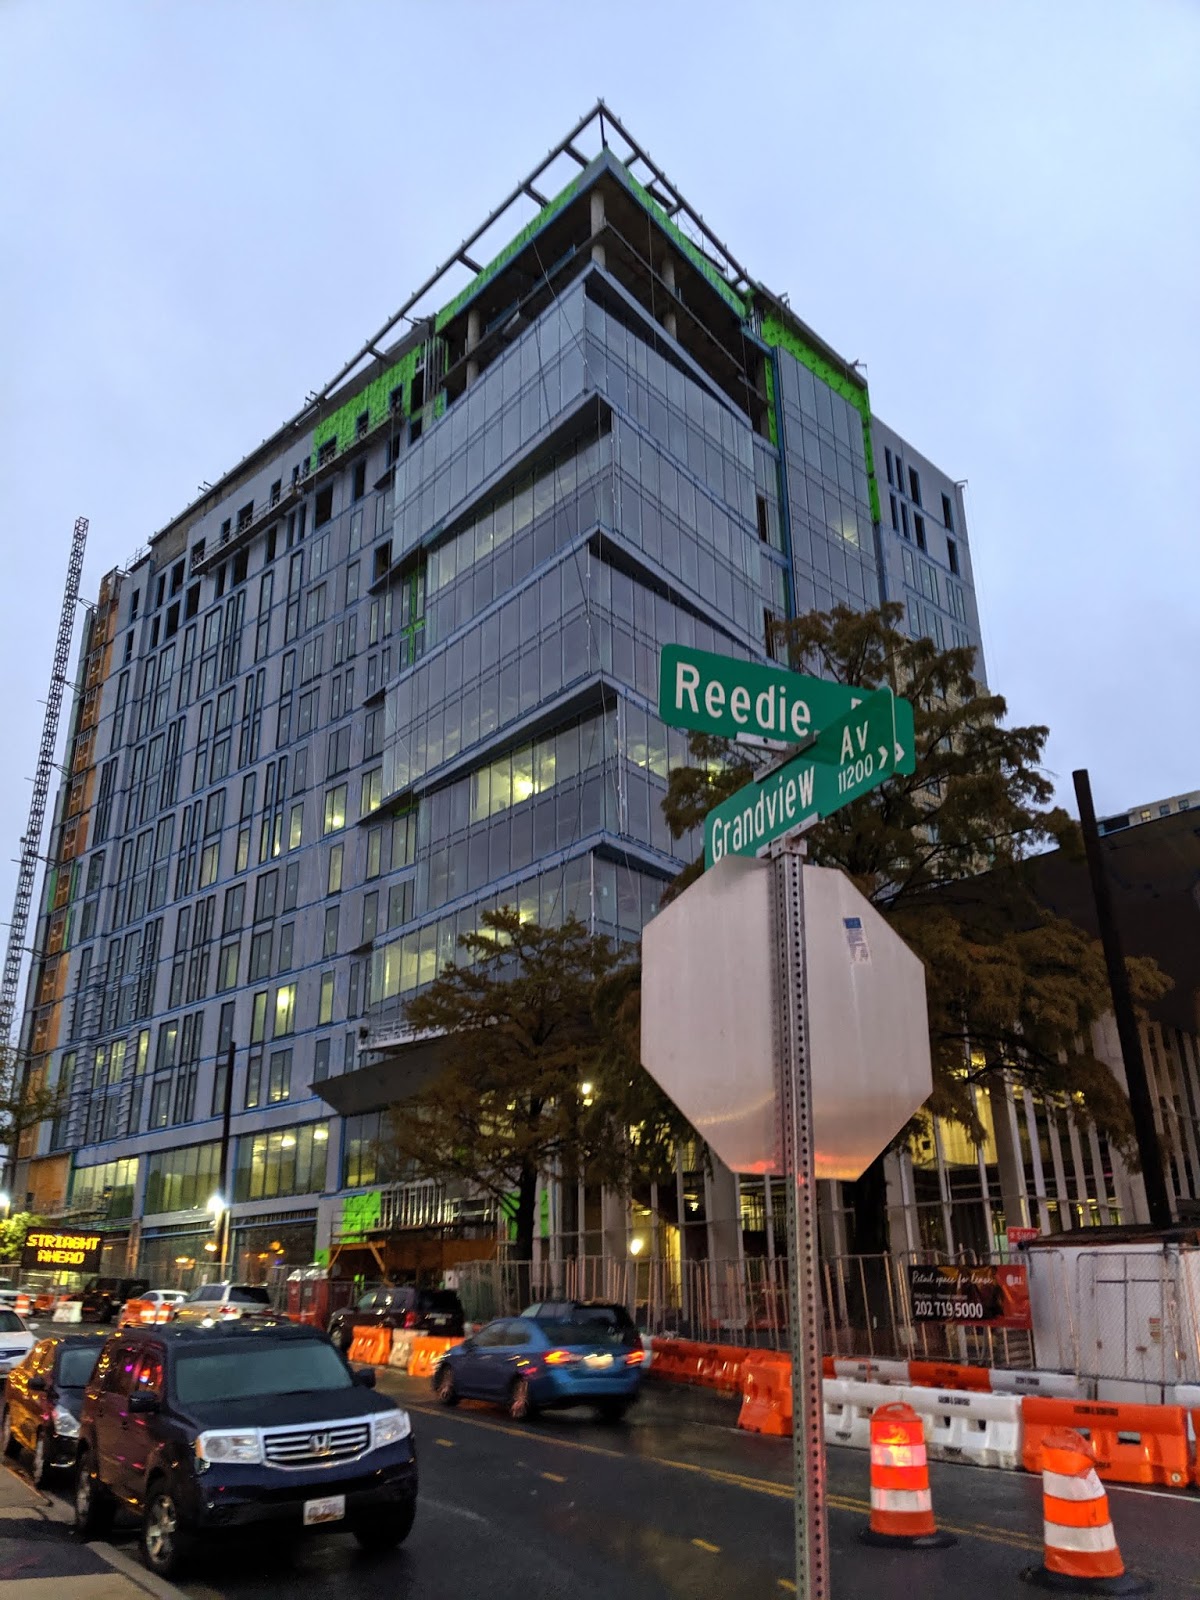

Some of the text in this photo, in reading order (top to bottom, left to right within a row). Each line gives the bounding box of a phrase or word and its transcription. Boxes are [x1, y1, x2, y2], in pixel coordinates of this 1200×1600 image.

[675, 661, 811, 737] Reedie
[837, 753, 873, 794] 11200
[711, 720, 869, 864] Grandview Av
[37, 1249, 85, 1264] AHEAD
[912, 1270, 934, 1284] Retail
[957, 1273, 969, 1291] for
[914, 1301, 983, 1318] 202 719 5000
